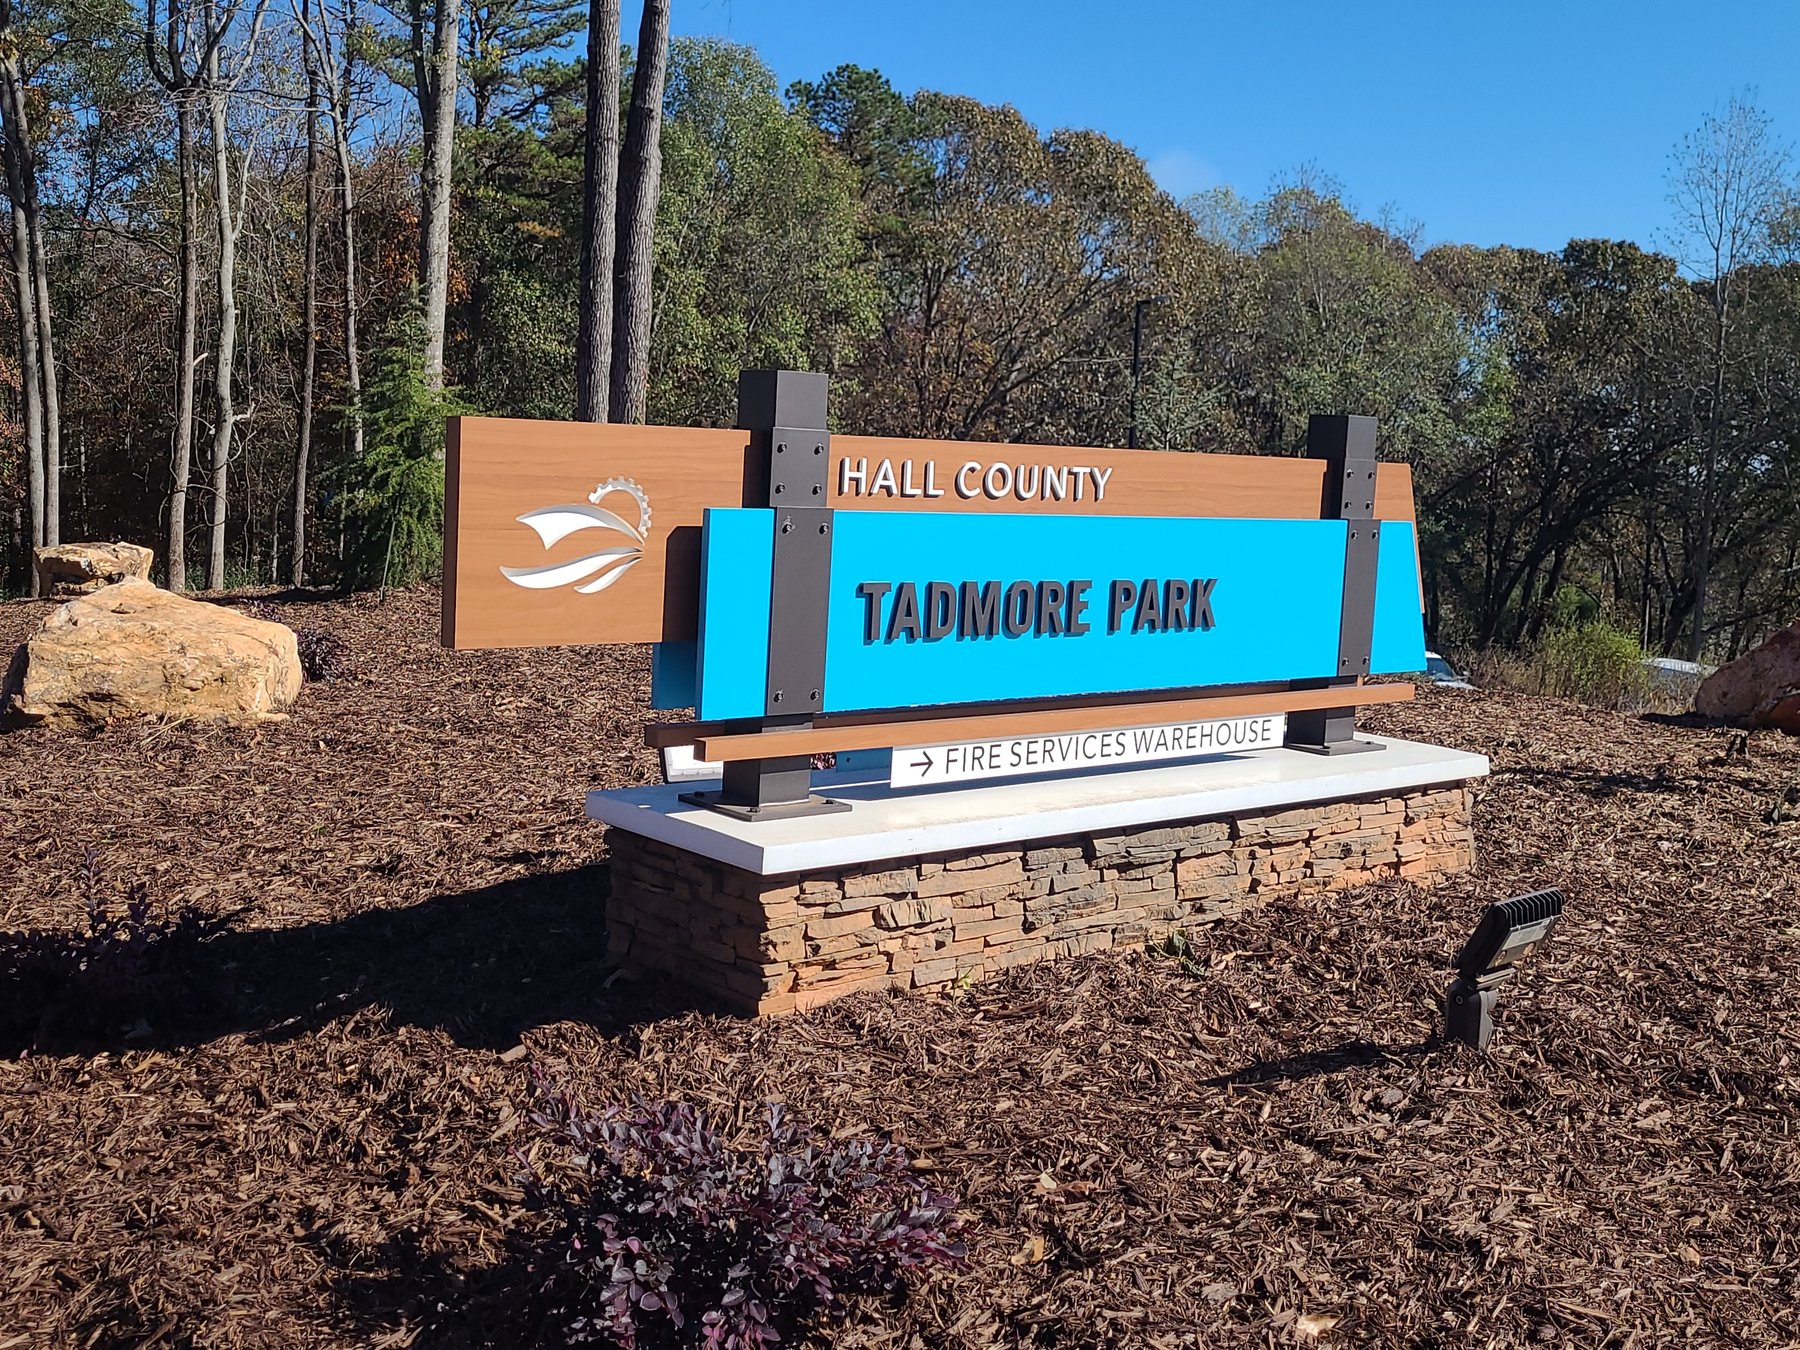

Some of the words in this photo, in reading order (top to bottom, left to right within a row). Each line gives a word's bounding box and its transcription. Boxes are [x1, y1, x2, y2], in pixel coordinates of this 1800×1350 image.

[839, 456, 945, 497] HALL
[955, 460, 1113, 502] COUNTY
[856, 580, 1093, 645] TADMORE
[1106, 578, 1218, 636] PARK
[945, 748, 1002, 774] FIRE
[1010, 732, 1126, 767] SERVICES
[1133, 719, 1273, 752] WAREHOUSE
